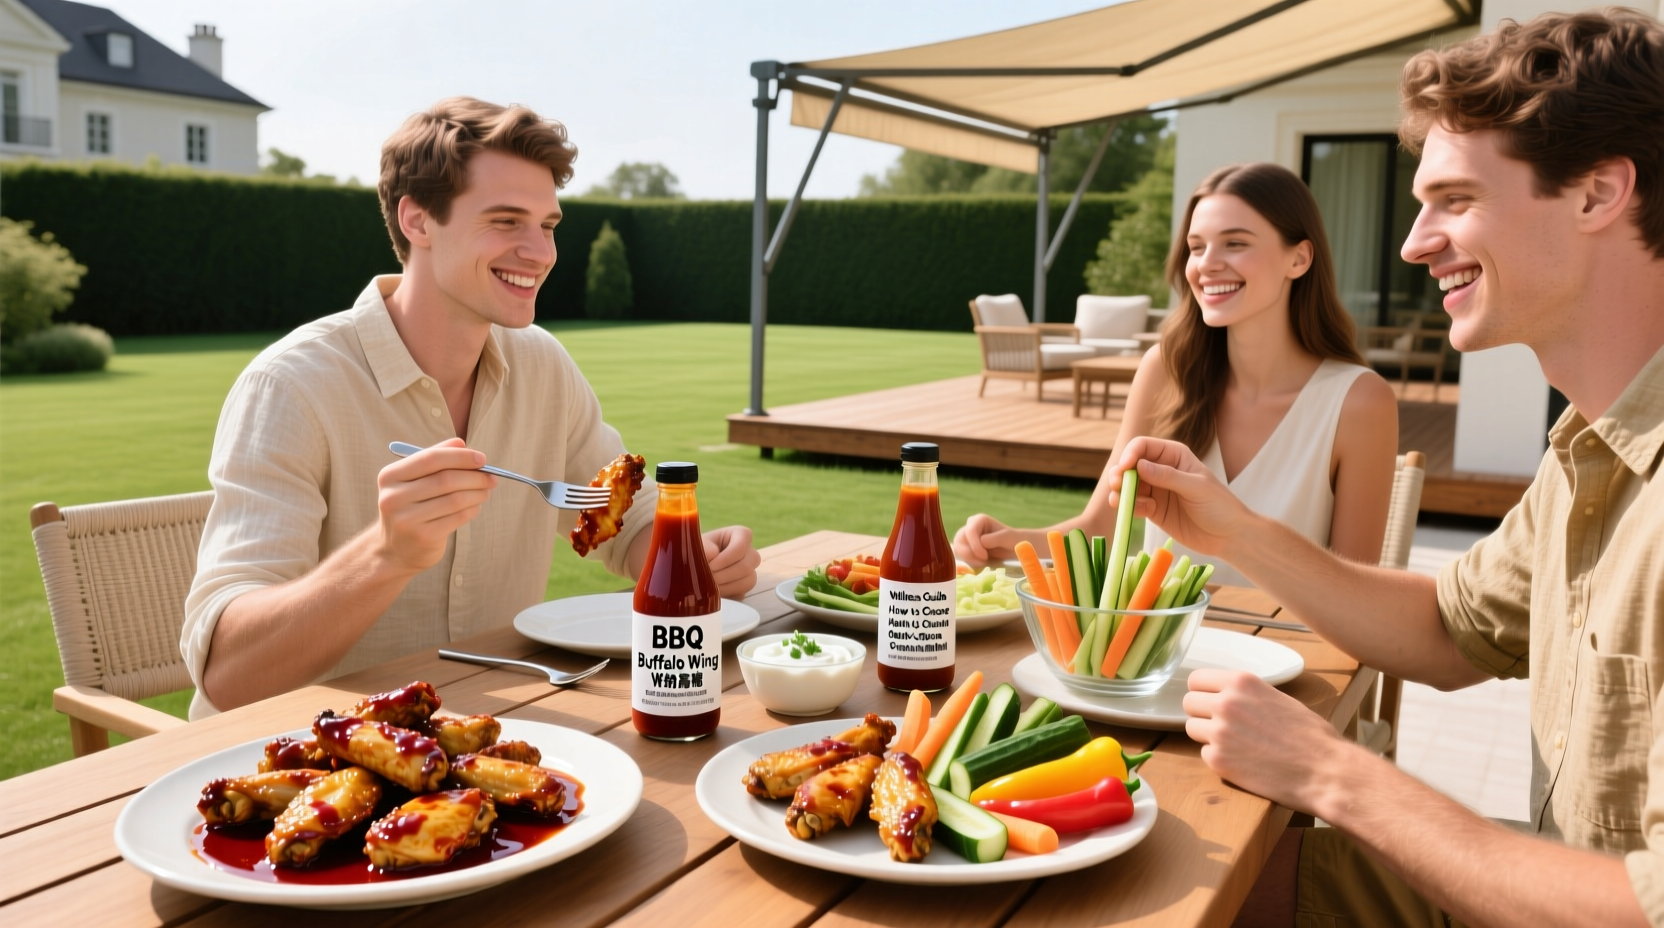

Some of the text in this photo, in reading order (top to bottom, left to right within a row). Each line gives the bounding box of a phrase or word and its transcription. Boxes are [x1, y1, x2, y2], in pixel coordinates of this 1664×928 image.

[889, 605, 908, 616] How
[652, 625, 704, 650] BBQ
[638, 652, 719, 671] Buffalo Wing
